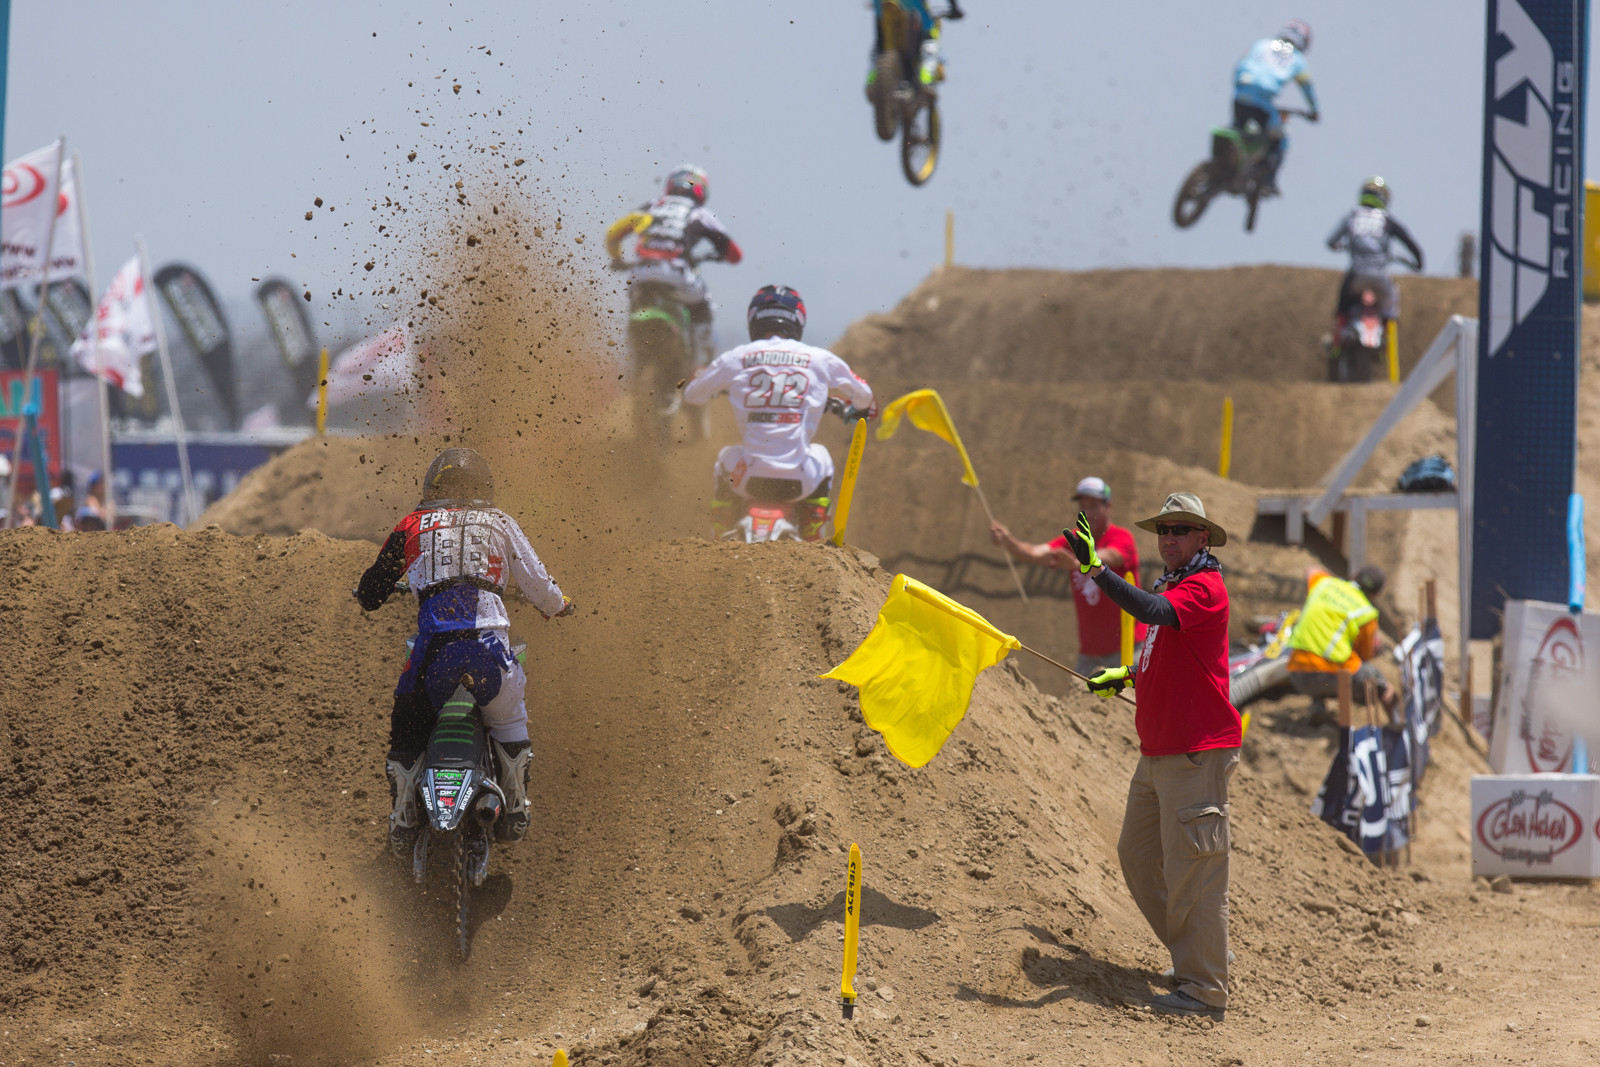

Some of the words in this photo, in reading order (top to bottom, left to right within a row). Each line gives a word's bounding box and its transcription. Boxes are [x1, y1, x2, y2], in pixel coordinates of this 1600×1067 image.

[1552, 61, 1575, 279] RACING
[744, 371, 809, 408] 212
[419, 509, 495, 532] EPSTEIN
[422, 787, 434, 810] DUNLOP
[459, 787, 474, 810] DUNLOP
[847, 862, 856, 916] ACERBIS
